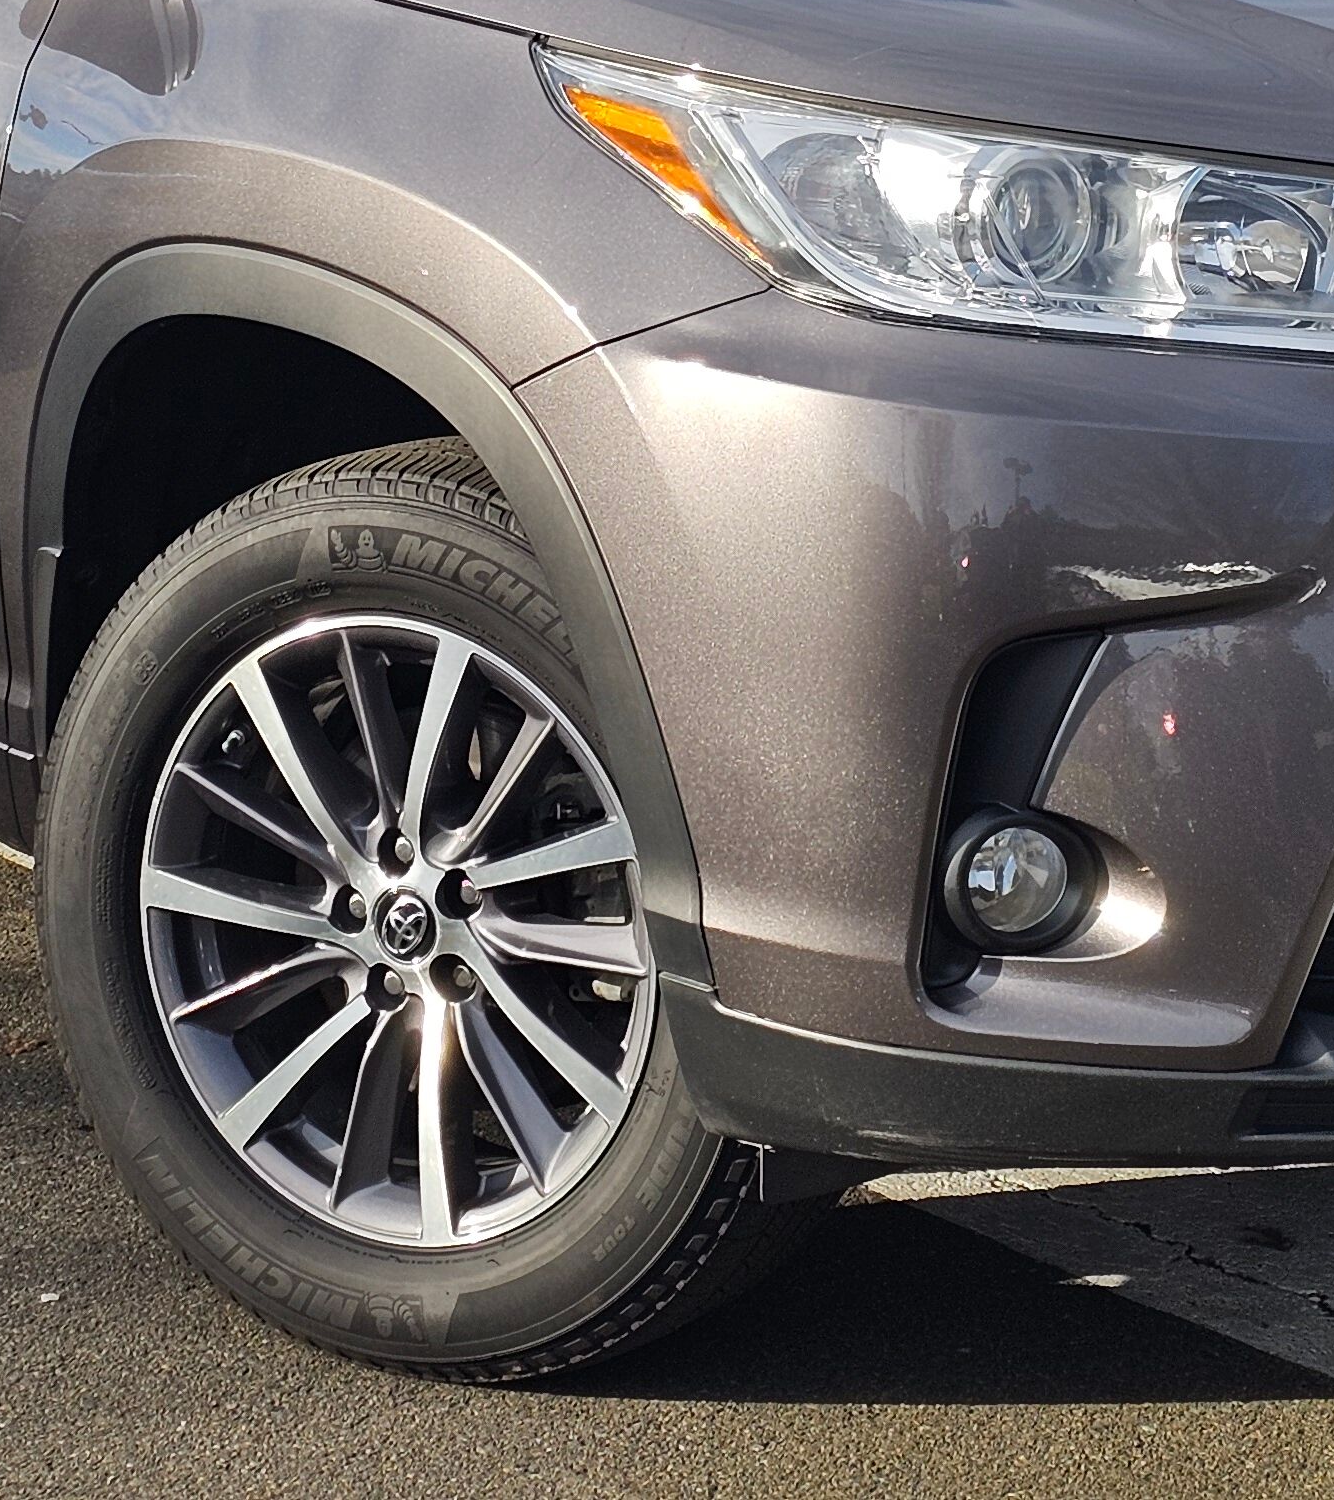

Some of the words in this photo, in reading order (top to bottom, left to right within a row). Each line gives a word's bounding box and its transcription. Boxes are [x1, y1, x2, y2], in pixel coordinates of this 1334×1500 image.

[392, 533, 576, 657] MICHEL
[135, 1153, 359, 1329] MICHELIN
[593, 1215, 636, 1262] TOUR
